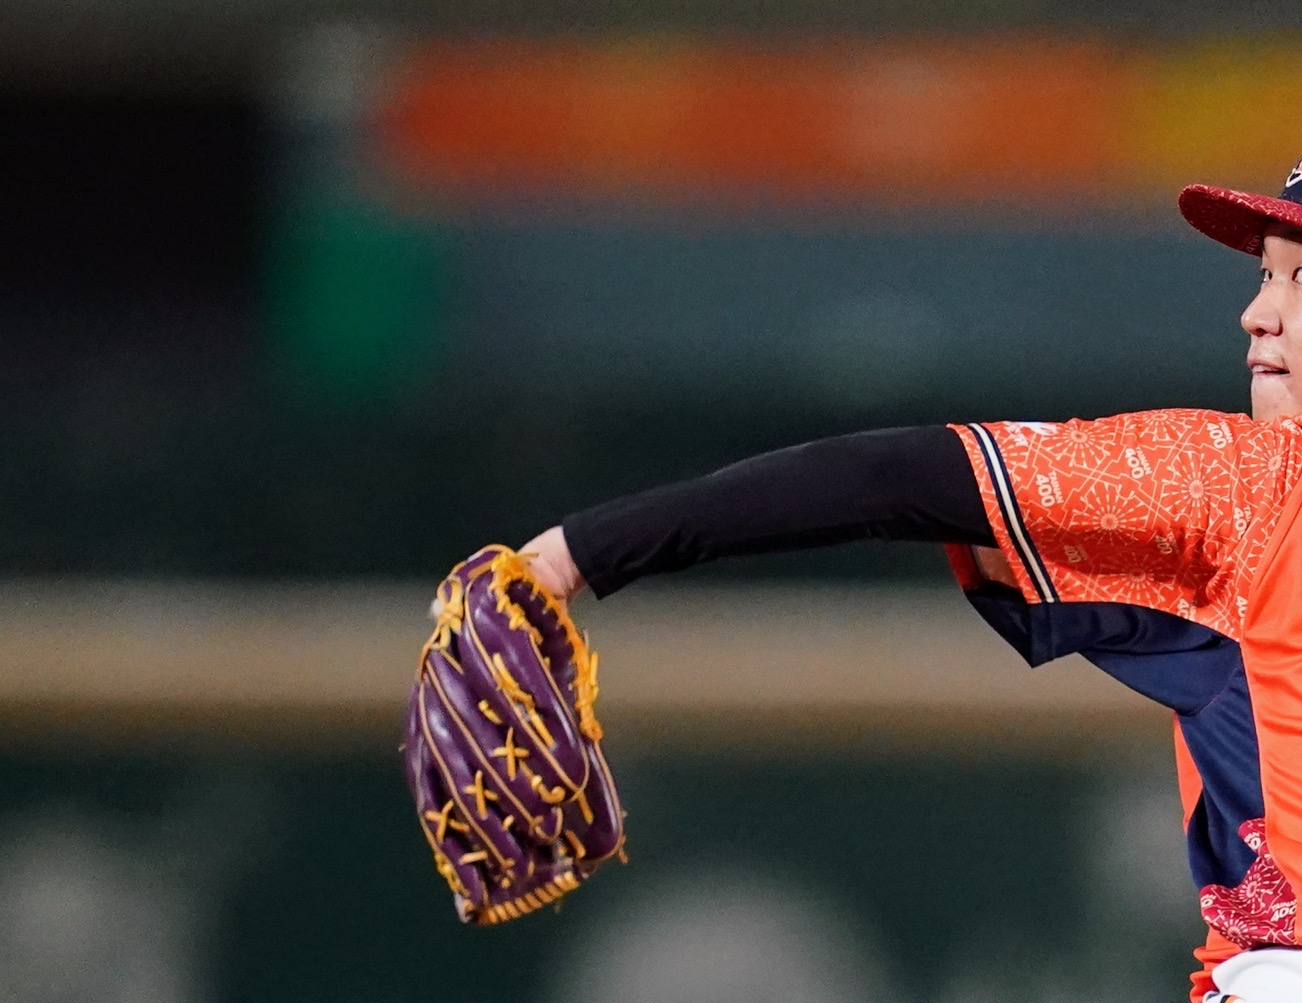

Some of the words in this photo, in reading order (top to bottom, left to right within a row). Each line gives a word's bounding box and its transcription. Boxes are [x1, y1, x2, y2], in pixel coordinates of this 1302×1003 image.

[1206, 422, 1227, 449] 400
[1125, 448, 1144, 479] 400
[1135, 446, 1152, 475] TAINAN
[1036, 473, 1055, 507] 400
[1048, 470, 1064, 504] TAINAN
